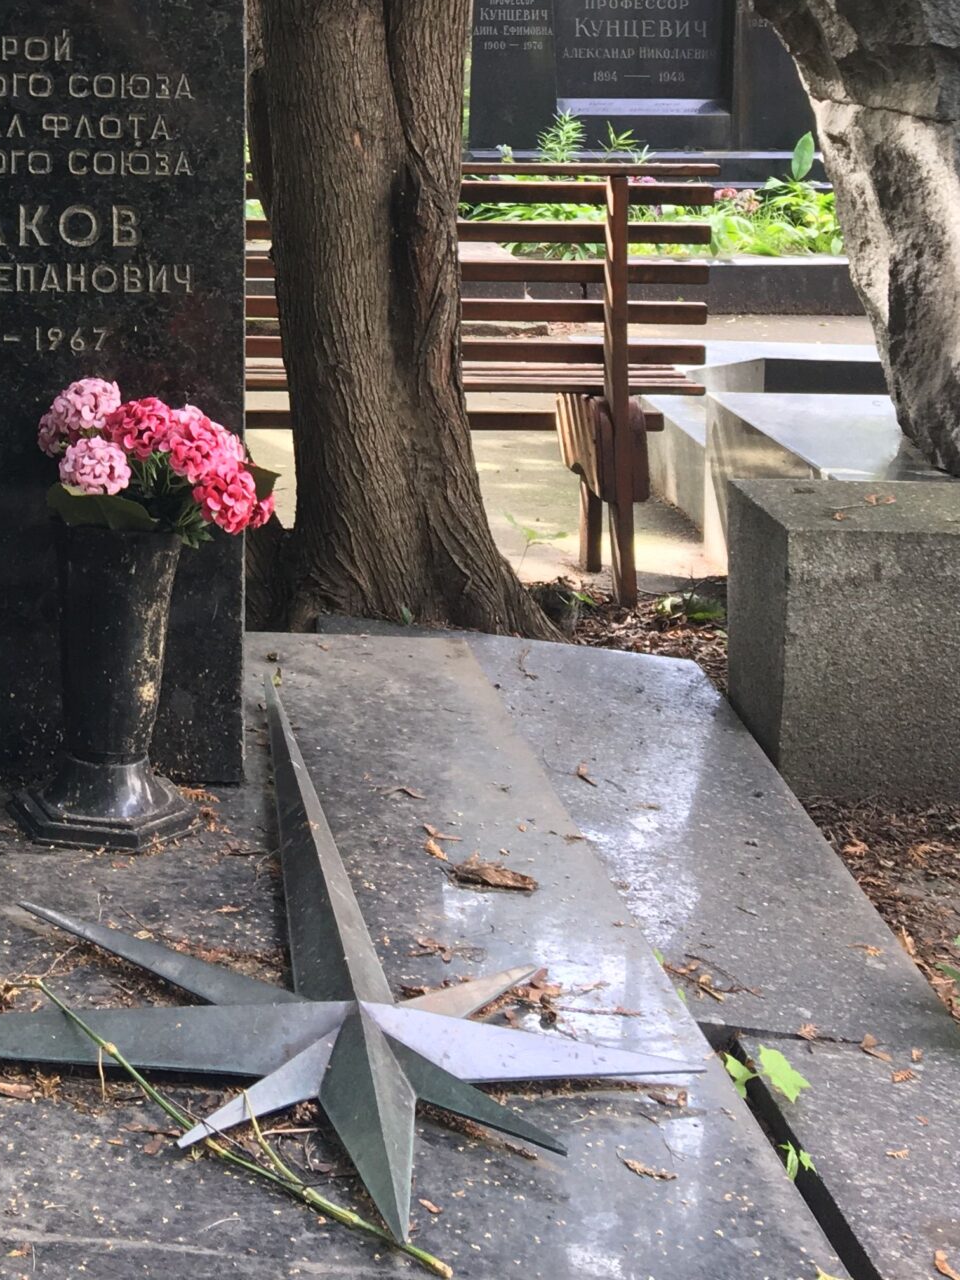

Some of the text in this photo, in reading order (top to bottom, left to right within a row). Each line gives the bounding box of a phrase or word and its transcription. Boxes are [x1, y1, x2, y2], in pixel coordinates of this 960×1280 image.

[480, 8, 548, 21] КУНЦЕВИЧ
[575, 17, 708, 39] КУНЦЕВИЧ
[562, 47, 636, 60] АЛЕКСАНДР
[68, 72, 196, 101] СОЮЗА
[592, 71, 619, 83] 1894
[658, 71, 686, 83] 1948
[42, 113, 173, 141] ФЛОТА
[67, 147, 195, 177] СОЮЗА
[34, 326, 111, 354] 1967
